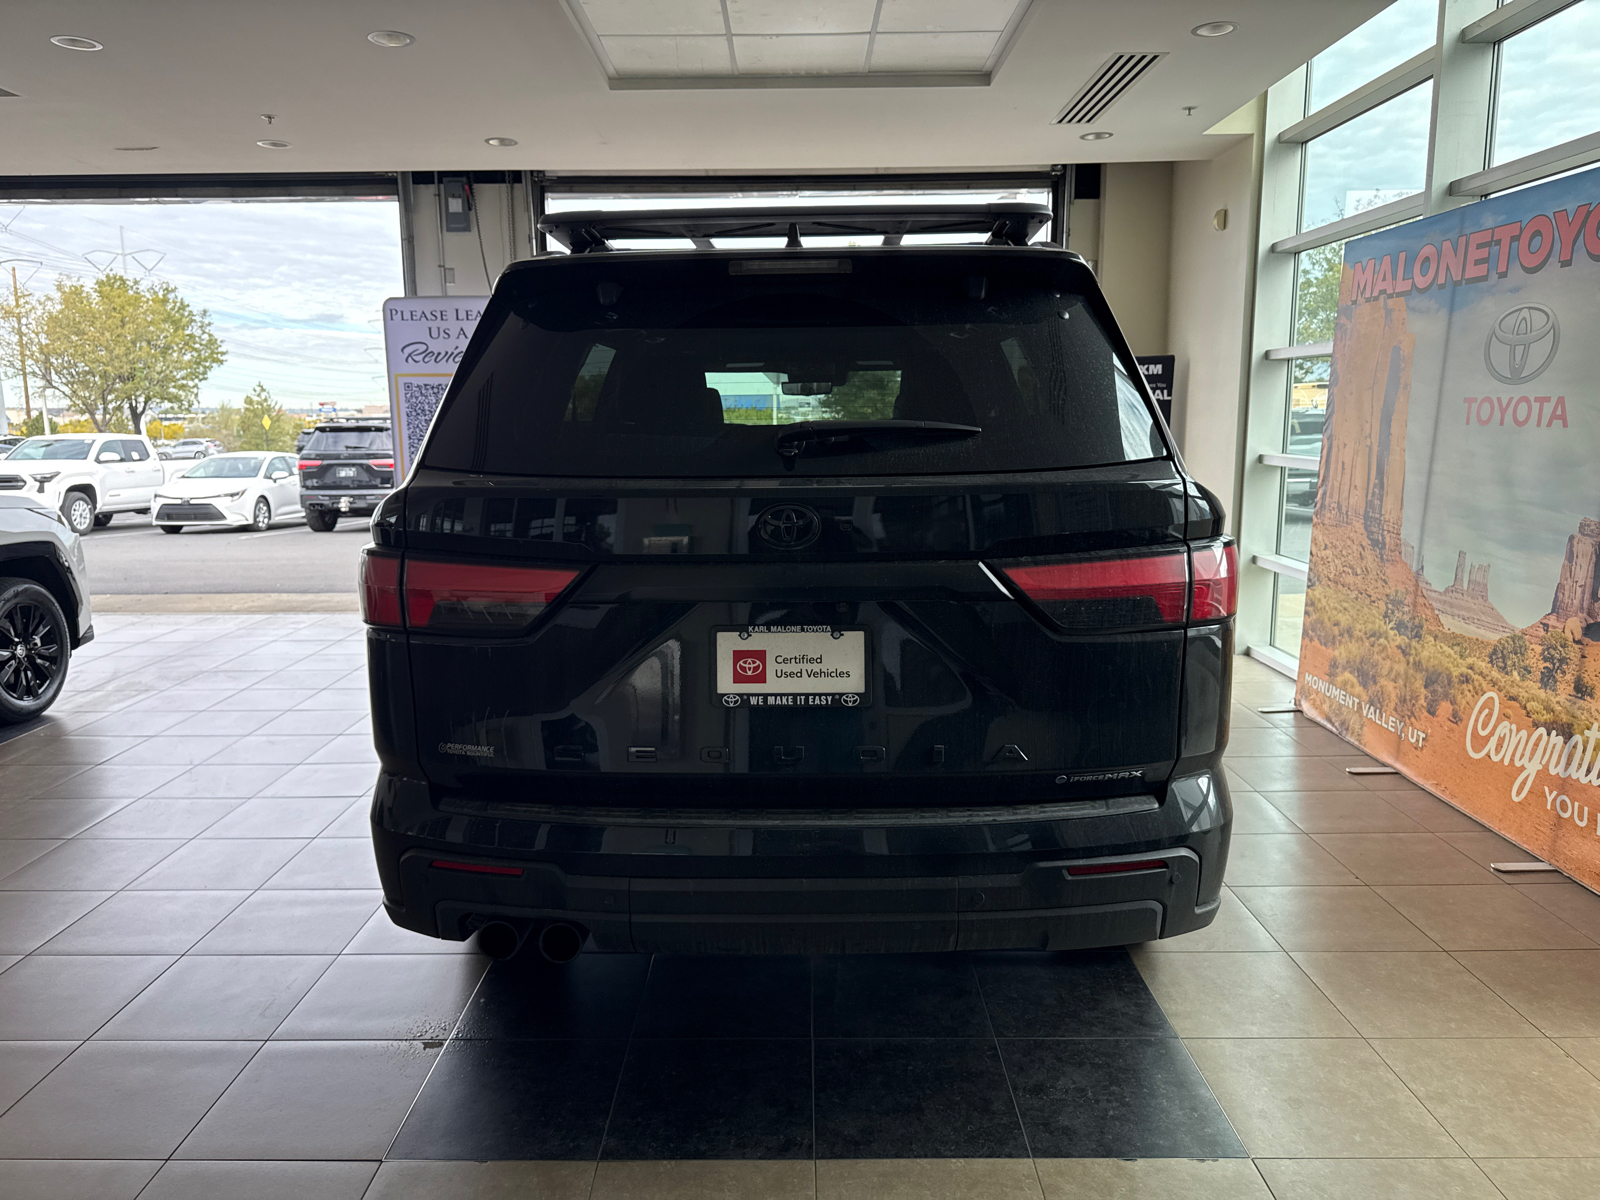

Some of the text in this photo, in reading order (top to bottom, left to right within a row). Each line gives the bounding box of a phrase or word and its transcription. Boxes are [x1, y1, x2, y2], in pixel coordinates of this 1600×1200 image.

[389, 308, 449, 322] PLEASE
[456, 326, 469, 340] A
[1463, 395, 1568, 428] TOYOTA
[748, 625, 832, 633] KARL MALONE TOYOTA
[774, 654, 823, 665] Certified
[775, 668, 851, 679] Used Vehicles
[749, 695, 833, 706] WE MAKE IT EASY
[1304, 671, 1427, 748] MONUMENT VALLEY, UT
[446, 742, 495, 753] PERFORMANCE
[1543, 785, 1589, 827] YOU
